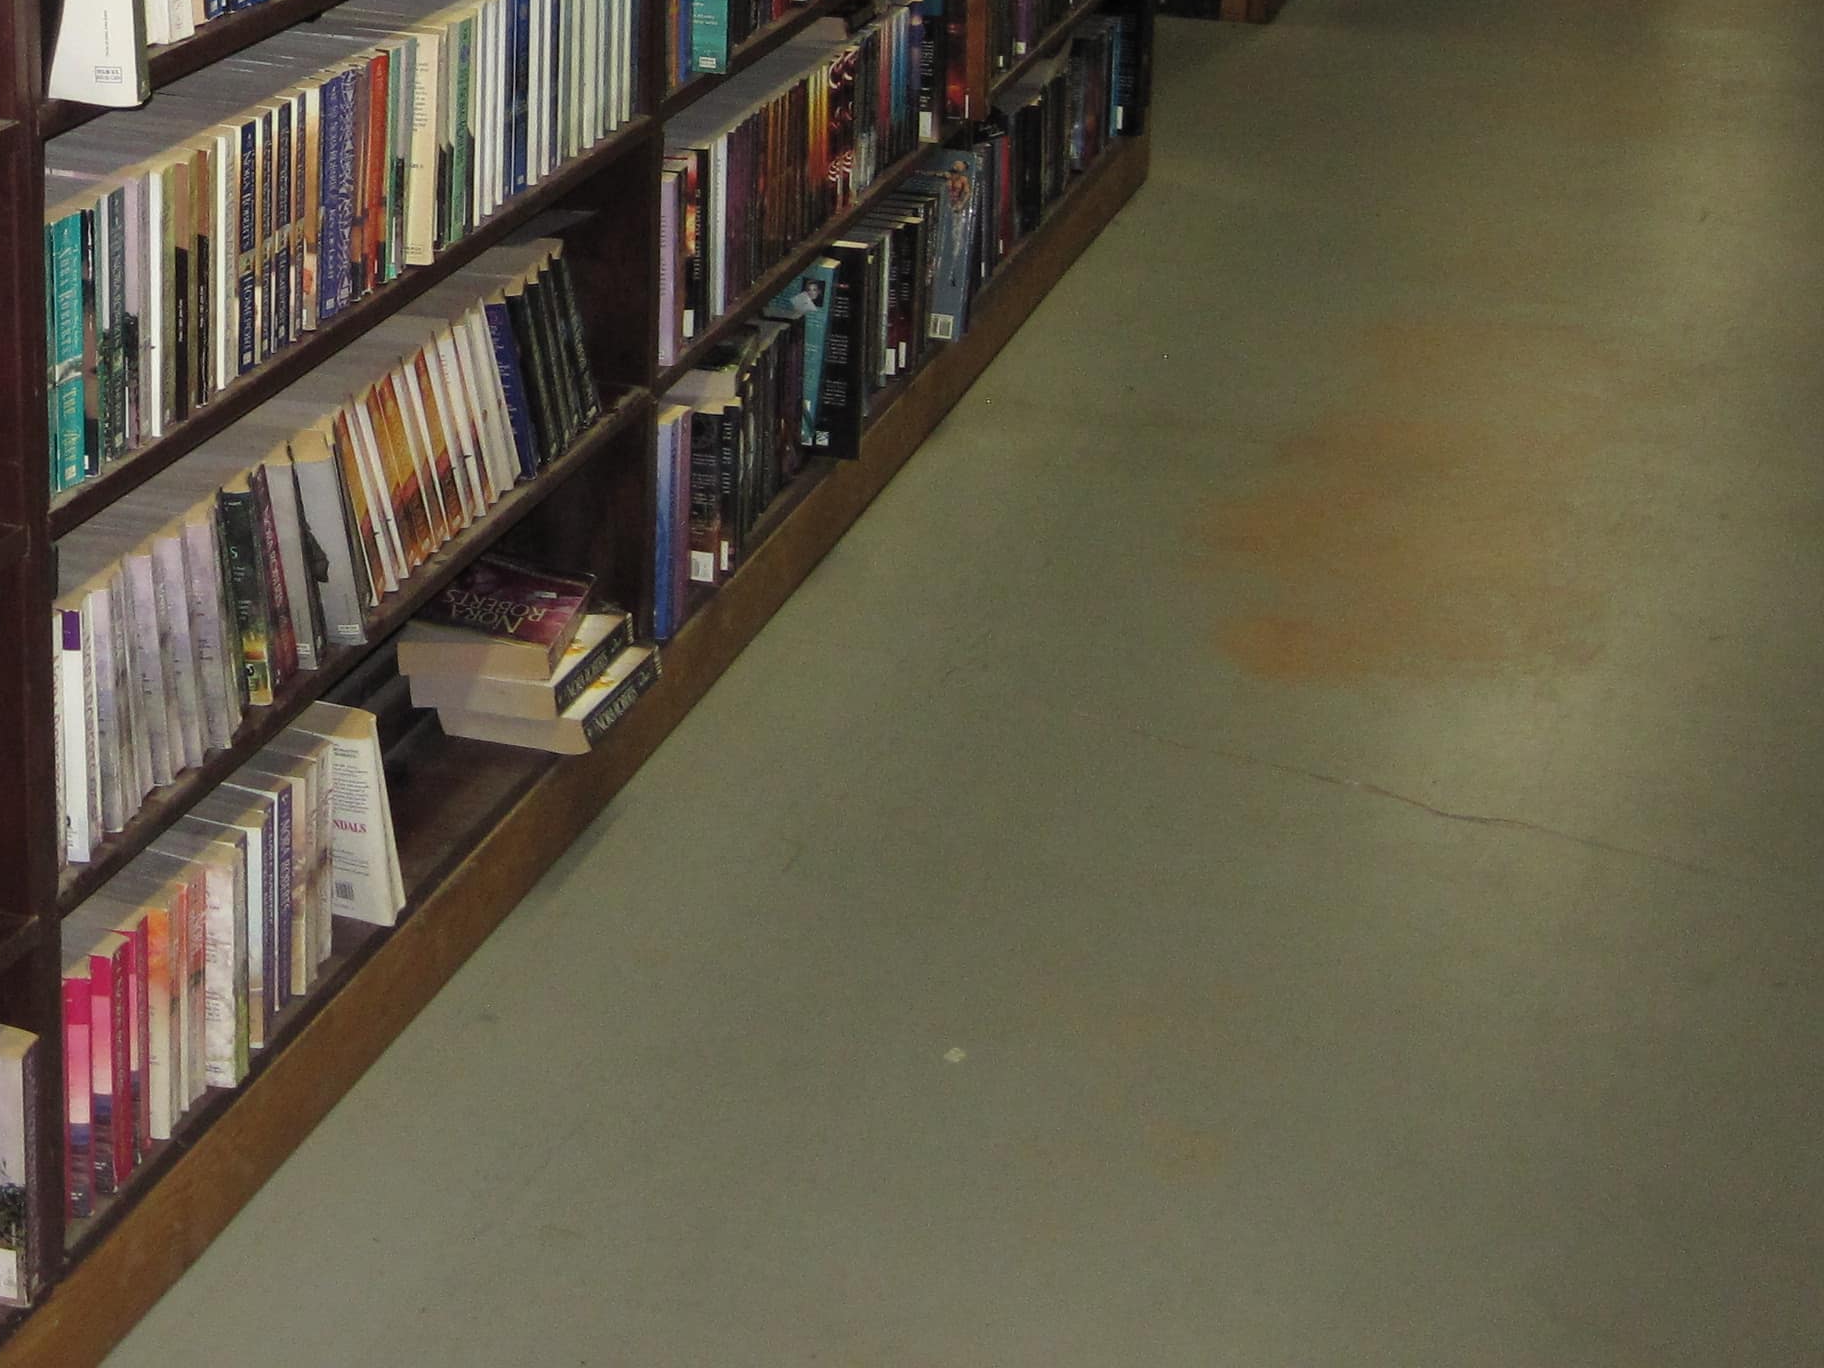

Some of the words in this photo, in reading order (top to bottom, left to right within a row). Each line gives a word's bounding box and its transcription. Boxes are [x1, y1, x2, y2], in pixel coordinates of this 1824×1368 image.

[444, 587, 546, 623] ROBERTS
[448, 604, 528, 637] NORA
[332, 820, 367, 833] NDALS
